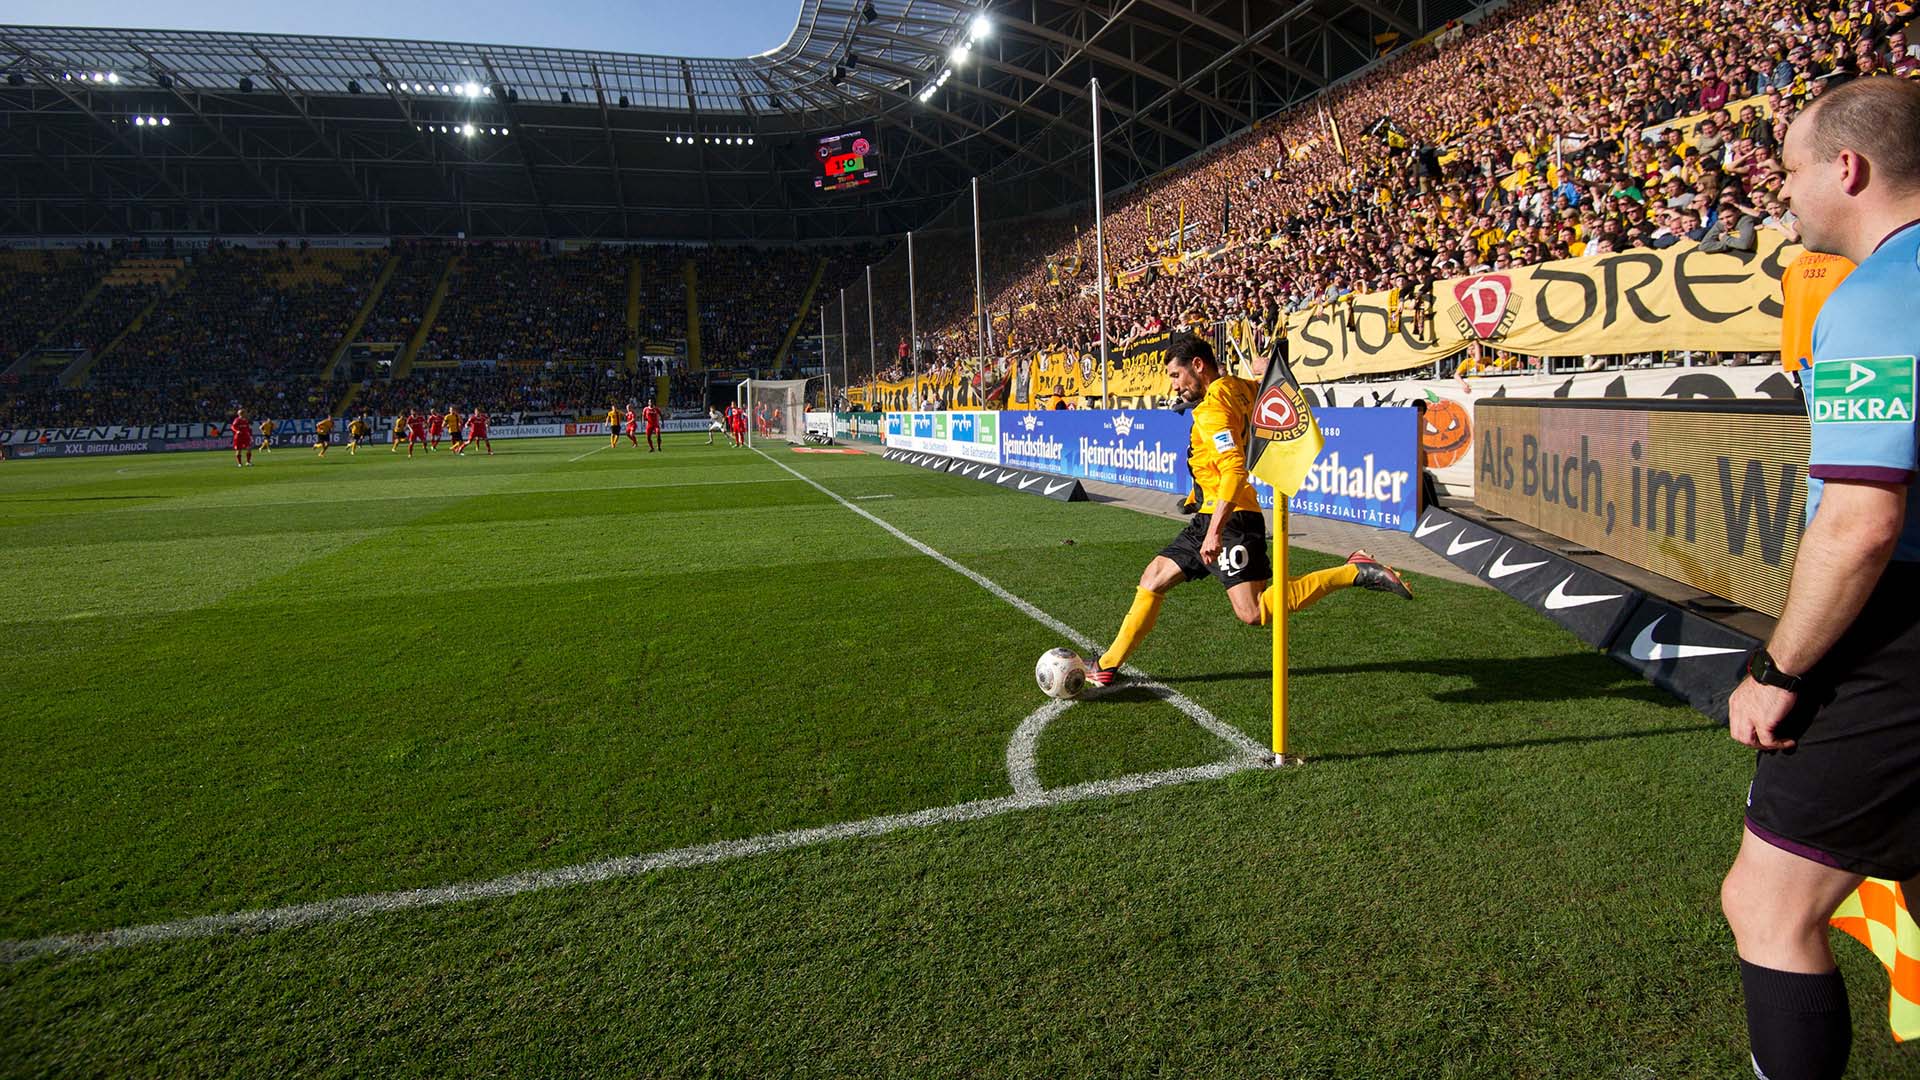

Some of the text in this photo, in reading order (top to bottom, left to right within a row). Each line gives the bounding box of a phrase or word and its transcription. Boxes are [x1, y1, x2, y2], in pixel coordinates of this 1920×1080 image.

[1802, 268, 1827, 279] 0332
[1273, 395, 1310, 442] DRESDEN
[1814, 397, 1909, 420] DEKRA
[541, 426, 554, 434] KG
[578, 423, 598, 433] HTI
[65, 444, 85, 454] XXL
[1002, 431, 1063, 464] Heinrichsthaler
[1079, 437, 1177, 476] Heinrichsthaler
[1480, 429, 1513, 490] Als
[1521, 434, 1616, 535] Buch,
[1630, 440, 1697, 543] im
[1290, 498, 1400, 525] KÄSESPEZIALITÄTEN
[1217, 544, 1249, 571] 40
